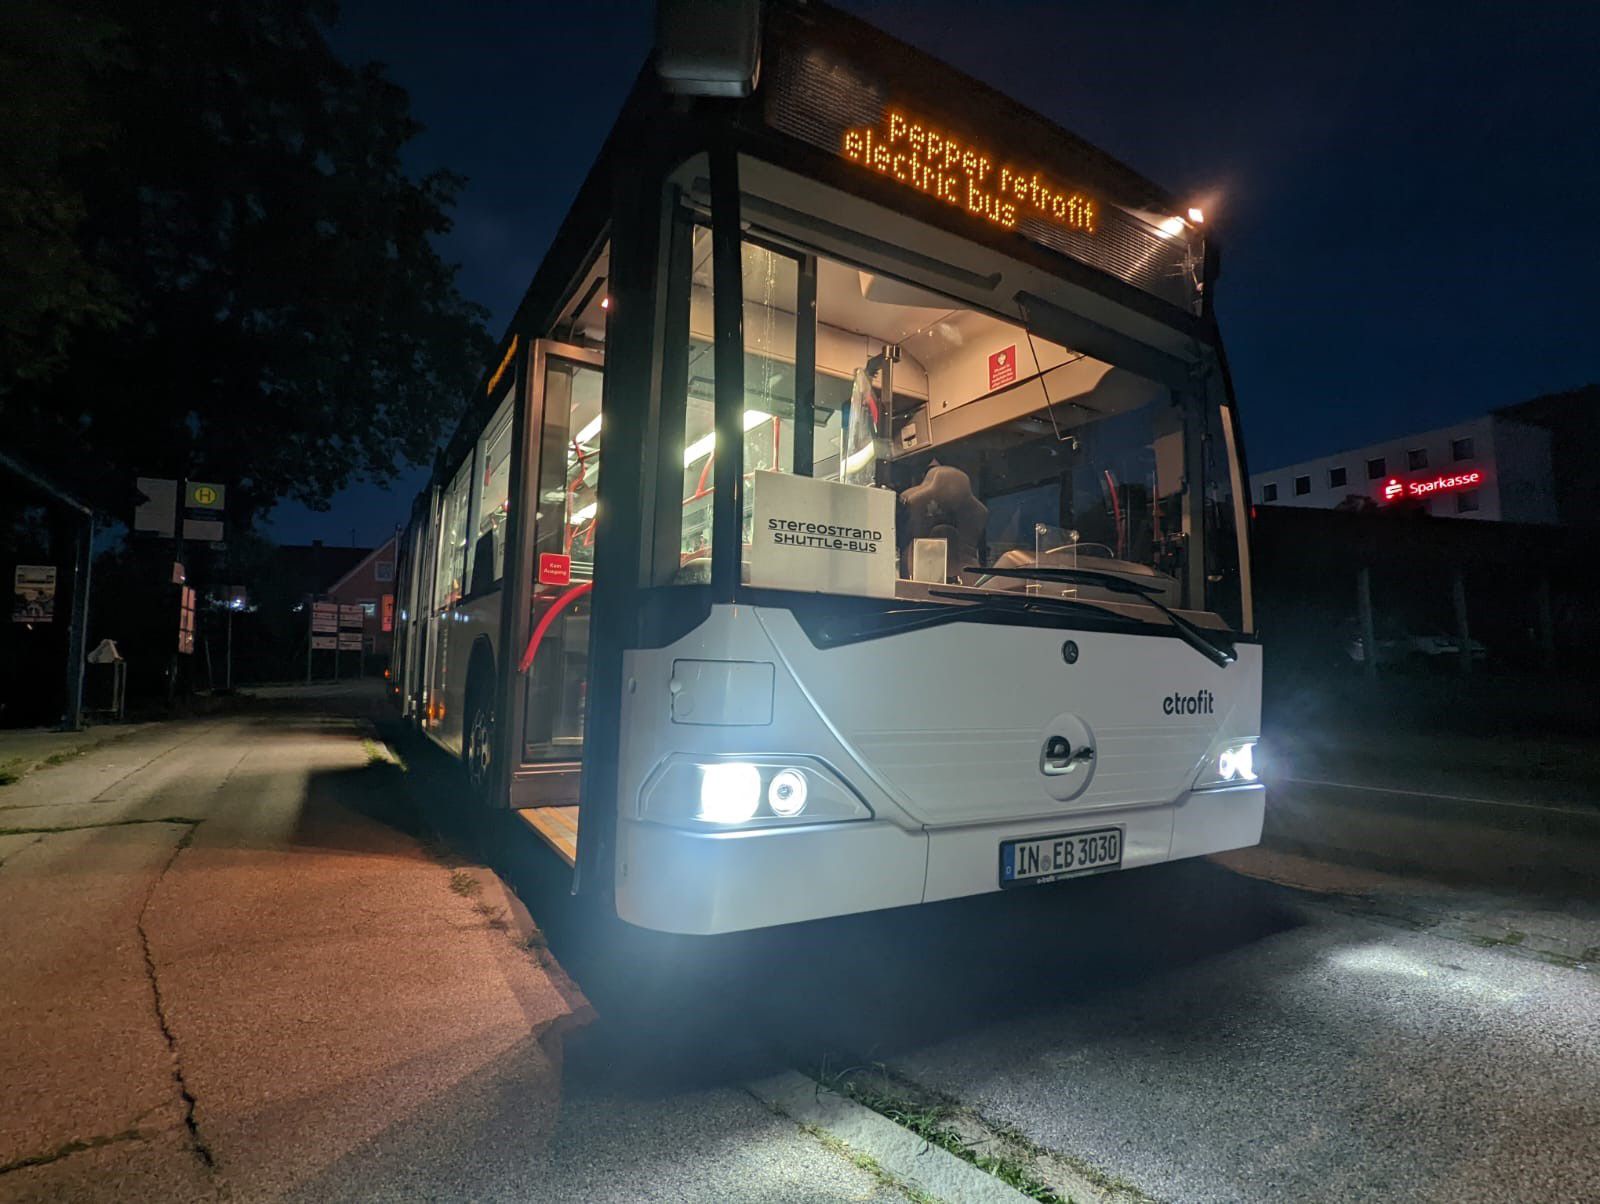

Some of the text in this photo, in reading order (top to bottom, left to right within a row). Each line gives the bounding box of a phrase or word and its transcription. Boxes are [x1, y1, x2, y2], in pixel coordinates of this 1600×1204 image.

[845, 129, 1016, 228] electric bus
[890, 112, 1094, 233] pepper retrofit
[1409, 472, 1480, 495] Sparkasse
[1162, 689, 1215, 716] etrofit
[1017, 834, 1117, 875] IN EB 3030
